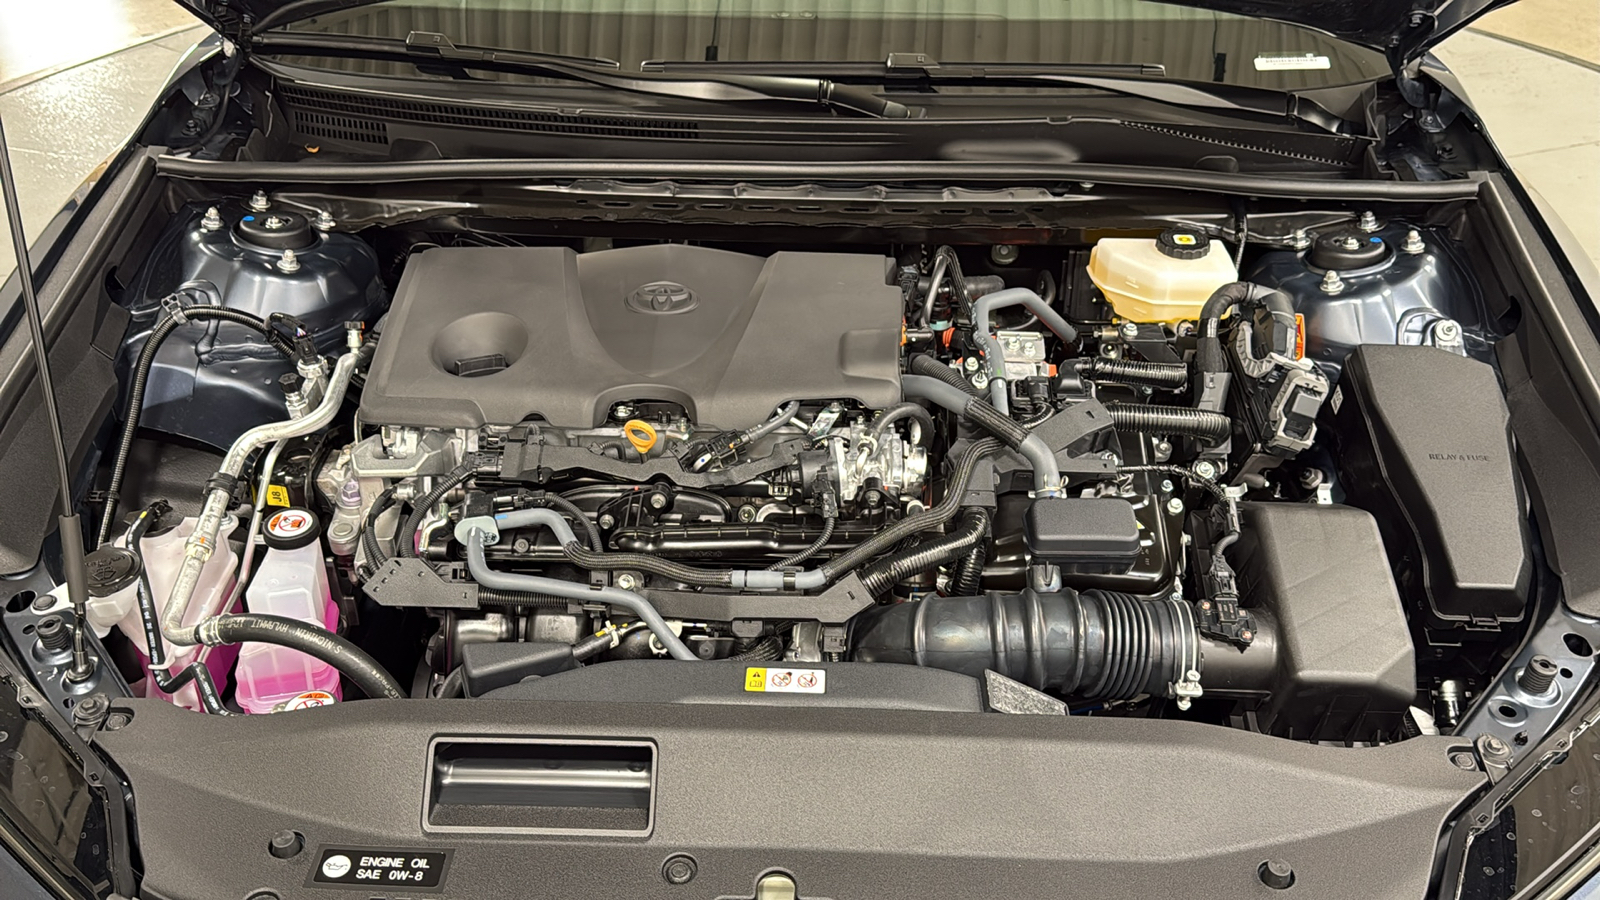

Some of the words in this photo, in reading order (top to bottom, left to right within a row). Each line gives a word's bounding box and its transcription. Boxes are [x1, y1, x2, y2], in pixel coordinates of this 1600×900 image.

[1467, 454, 1489, 462] FUSE
[271, 491, 282, 502] J8
[359, 856, 405, 867] ENGINE
[410, 858, 430, 869] OIL
[355, 869, 382, 880] SAE
[388, 870, 424, 881] 0W-8
